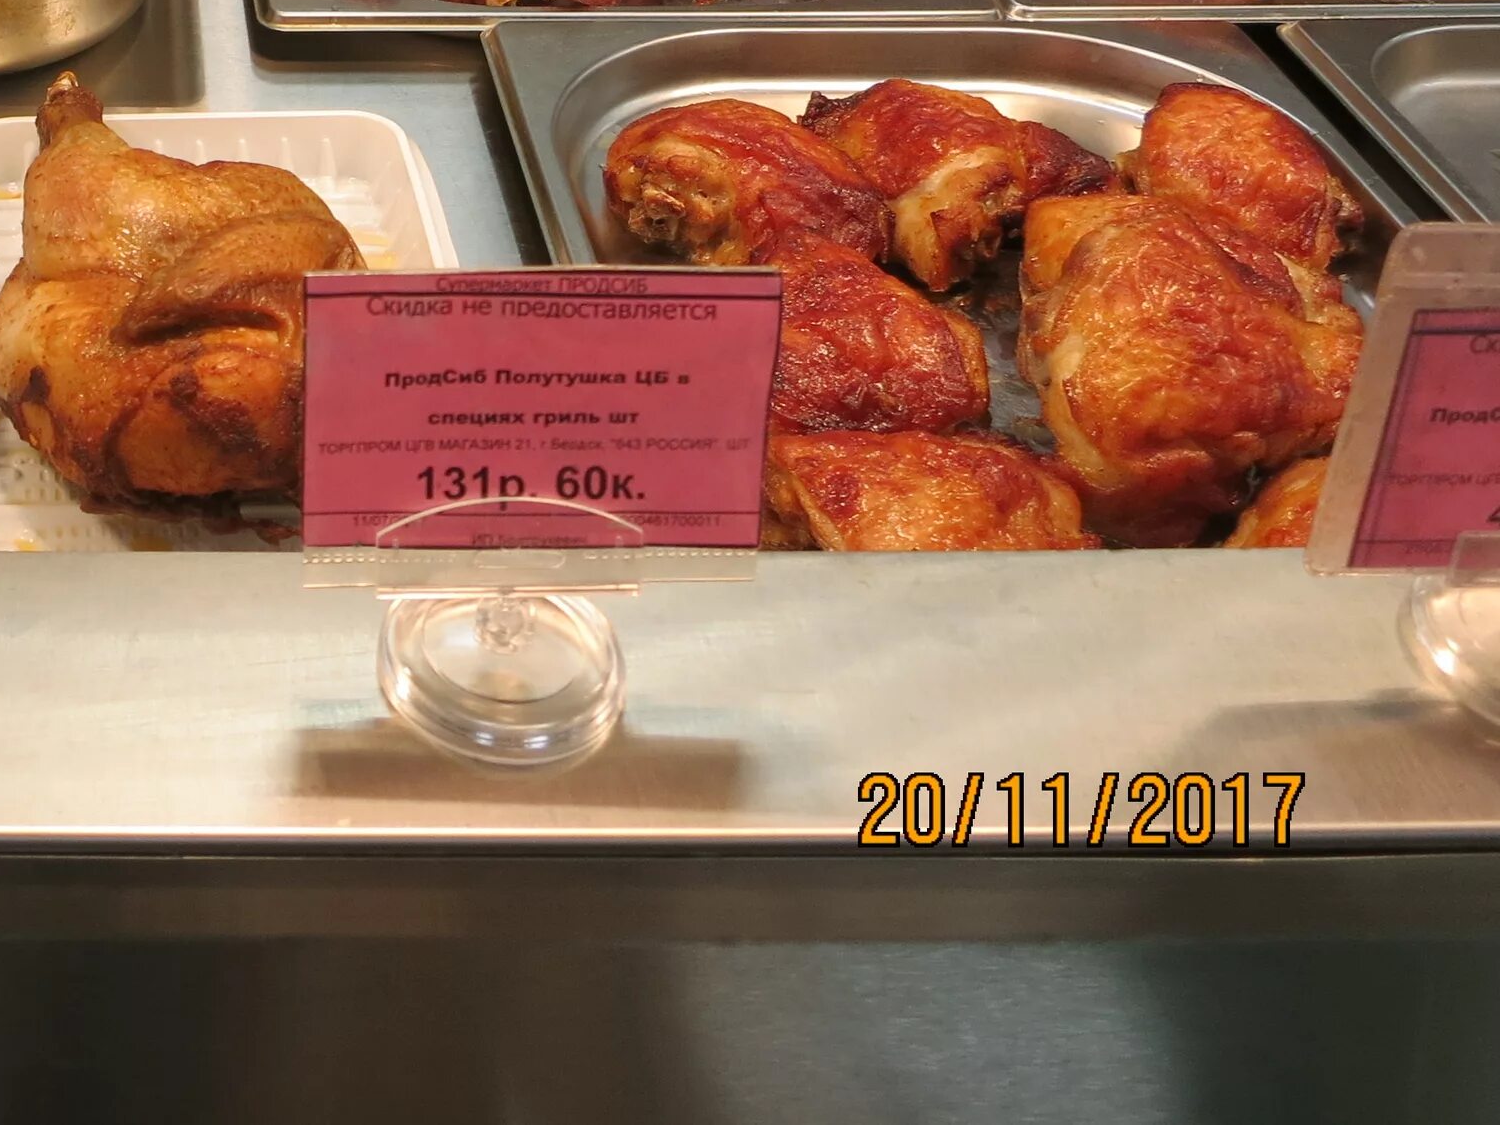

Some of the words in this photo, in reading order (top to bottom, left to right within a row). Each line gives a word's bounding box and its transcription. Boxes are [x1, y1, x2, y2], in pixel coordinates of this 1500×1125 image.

[436, 277, 550, 293] Супермаркет
[558, 277, 648, 294] ПРОДСИБ
[366, 296, 452, 317] Скидка
[462, 299, 493, 316] не
[501, 299, 717, 321] предоставляется
[385, 369, 486, 389] ПродСиб
[495, 370, 626, 388] Полутушка
[635, 370, 669, 387] ЦБ
[678, 374, 691, 385] в
[428, 412, 524, 426] специях
[533, 411, 600, 426] гриль
[609, 412, 639, 424] шт
[318, 440, 401, 455] ТОРГПРОМ
[439, 438, 511, 452] МАГАЗИН
[727, 437, 750, 452] ШТ
[417, 466, 537, 511] 131р.
[556, 465, 646, 500] 60к.
